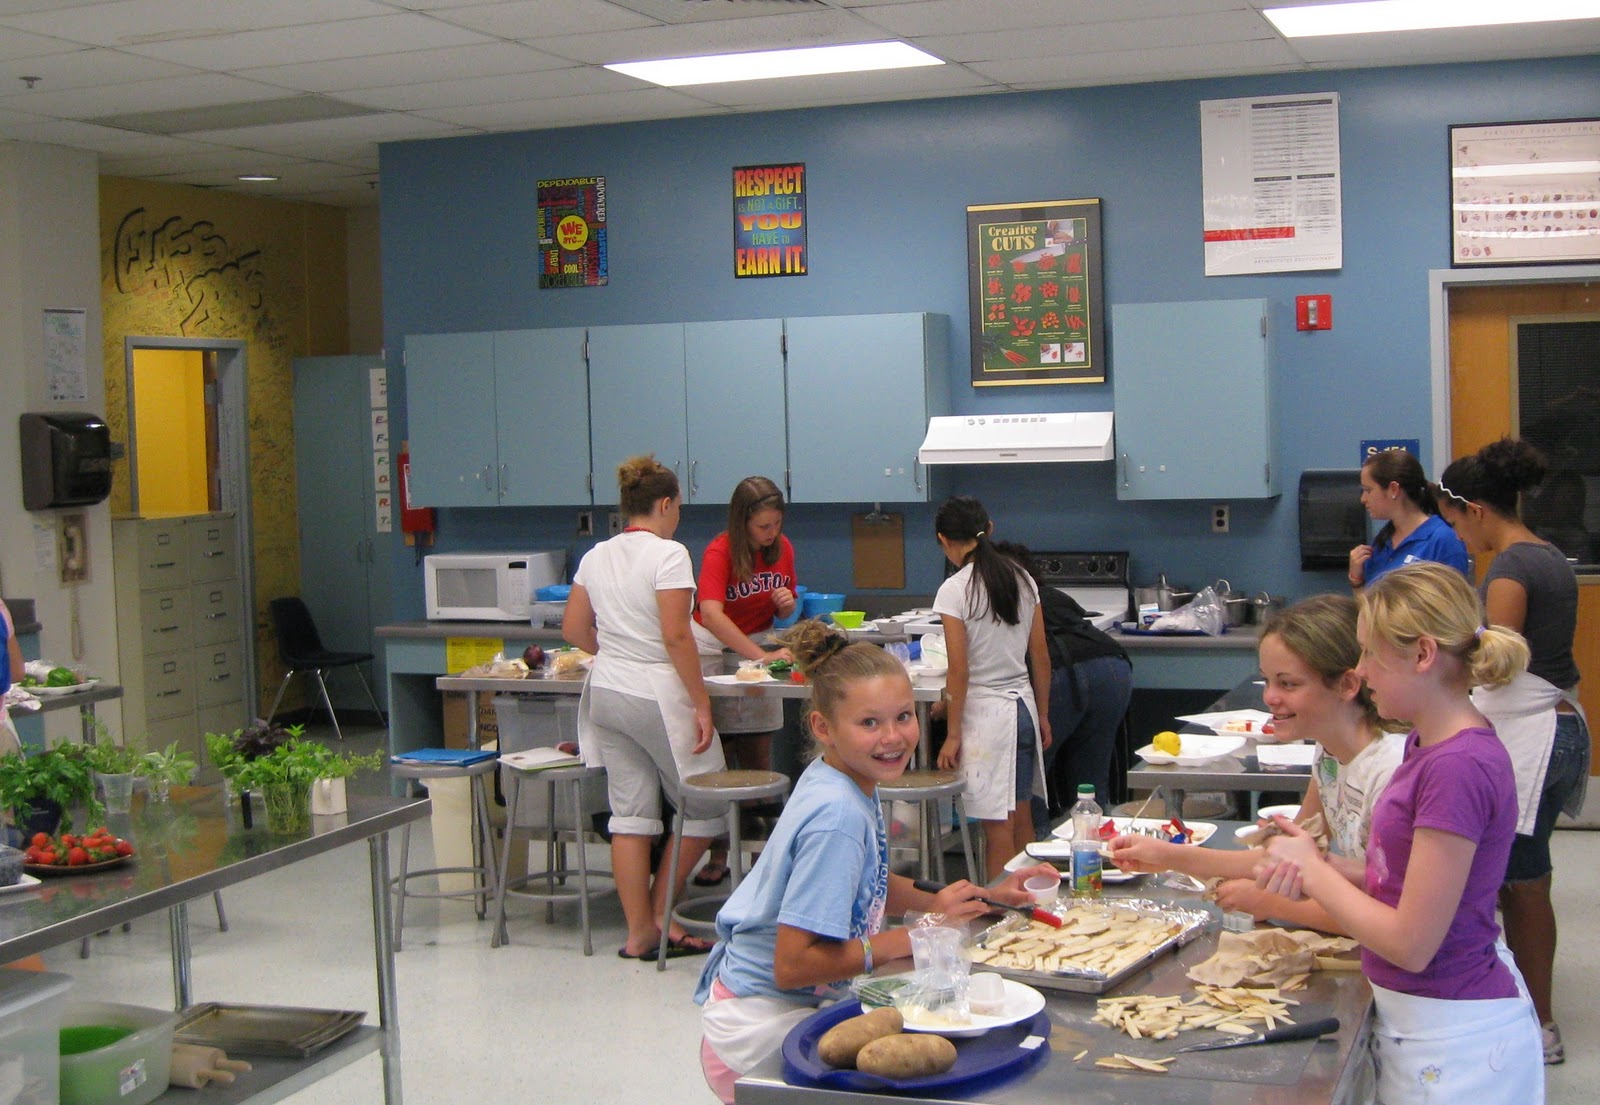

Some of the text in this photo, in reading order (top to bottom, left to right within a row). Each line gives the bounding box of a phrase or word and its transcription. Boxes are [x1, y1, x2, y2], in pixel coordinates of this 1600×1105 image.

[538, 178, 597, 188] DEPENDABLE
[736, 166, 804, 197] RESPECT
[597, 177, 605, 222] EMPOWERED
[738, 204, 745, 213] IS
[747, 198, 766, 212] NOT
[560, 221, 583, 236] WE
[738, 213, 802, 231] YOU
[752, 232, 779, 246] HAVE
[988, 225, 1038, 237] Creative
[991, 235, 1036, 252] CUTS
[550, 250, 559, 267] LIVELY
[737, 247, 781, 276] EARN
[564, 264, 579, 274] COOL
